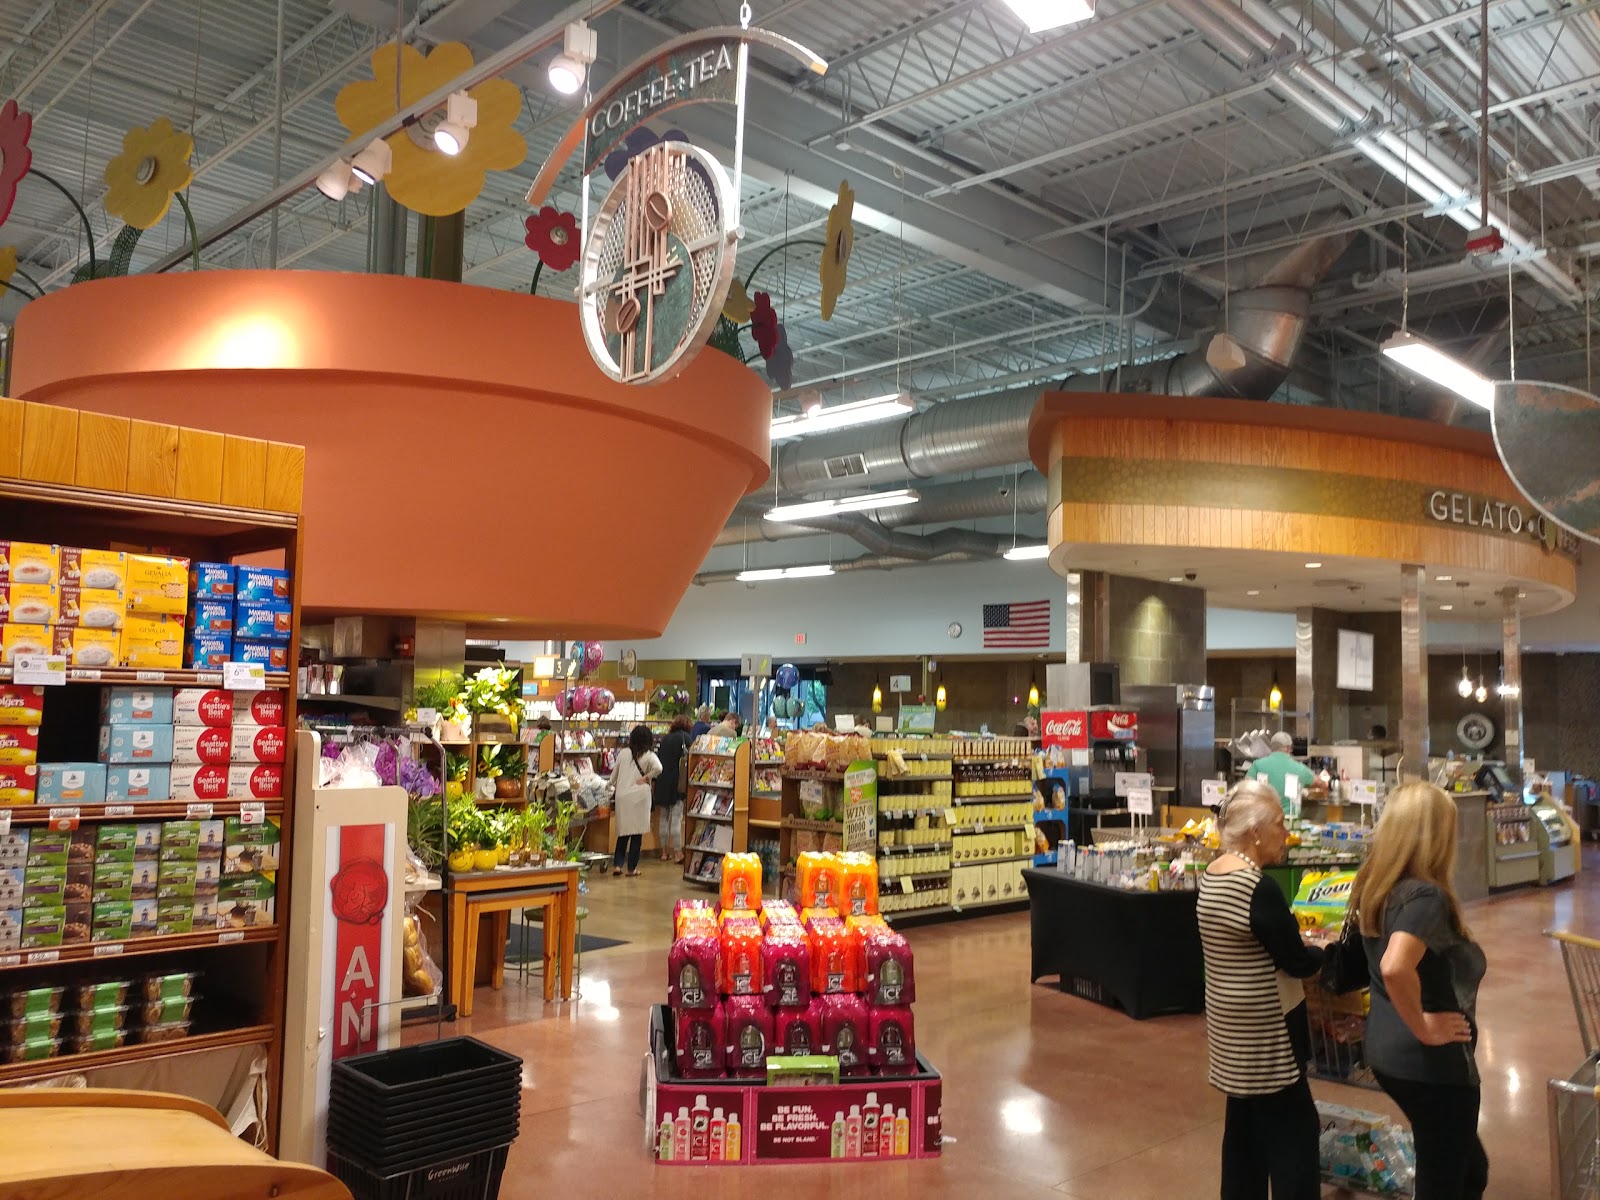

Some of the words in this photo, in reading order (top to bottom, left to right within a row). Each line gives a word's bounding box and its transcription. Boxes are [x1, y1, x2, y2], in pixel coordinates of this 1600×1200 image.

[591, 69, 677, 137] COFFEE
[685, 44, 731, 89] TEA
[1430, 490, 1522, 534] GELATO
[145, 570, 171, 578] GEVALIA
[205, 568, 228, 576] MAXWELL
[248, 573, 273, 581] MAXWELL
[248, 609, 274, 617] MAXWELL
[201, 640, 224, 648] MAXWELL
[244, 644, 269, 652] MAXWELL
[556, 661, 562, 674] 3
[747, 658, 751, 670] 1
[202, 702, 230, 710] Seattle's
[255, 702, 281, 710] Seattle's
[1046, 718, 1082, 736] Coca-Cola
[201, 740, 228, 748] Seattle's
[257, 739, 283, 747] Seattle's
[263, 744, 277, 752] Best
[846, 805, 866, 819] WIN
[777, 1105, 790, 1114] BE
[772, 1114, 784, 1122] BE
[760, 1122, 773, 1131] BE
[428, 1162, 470, 1181] GreenWise
